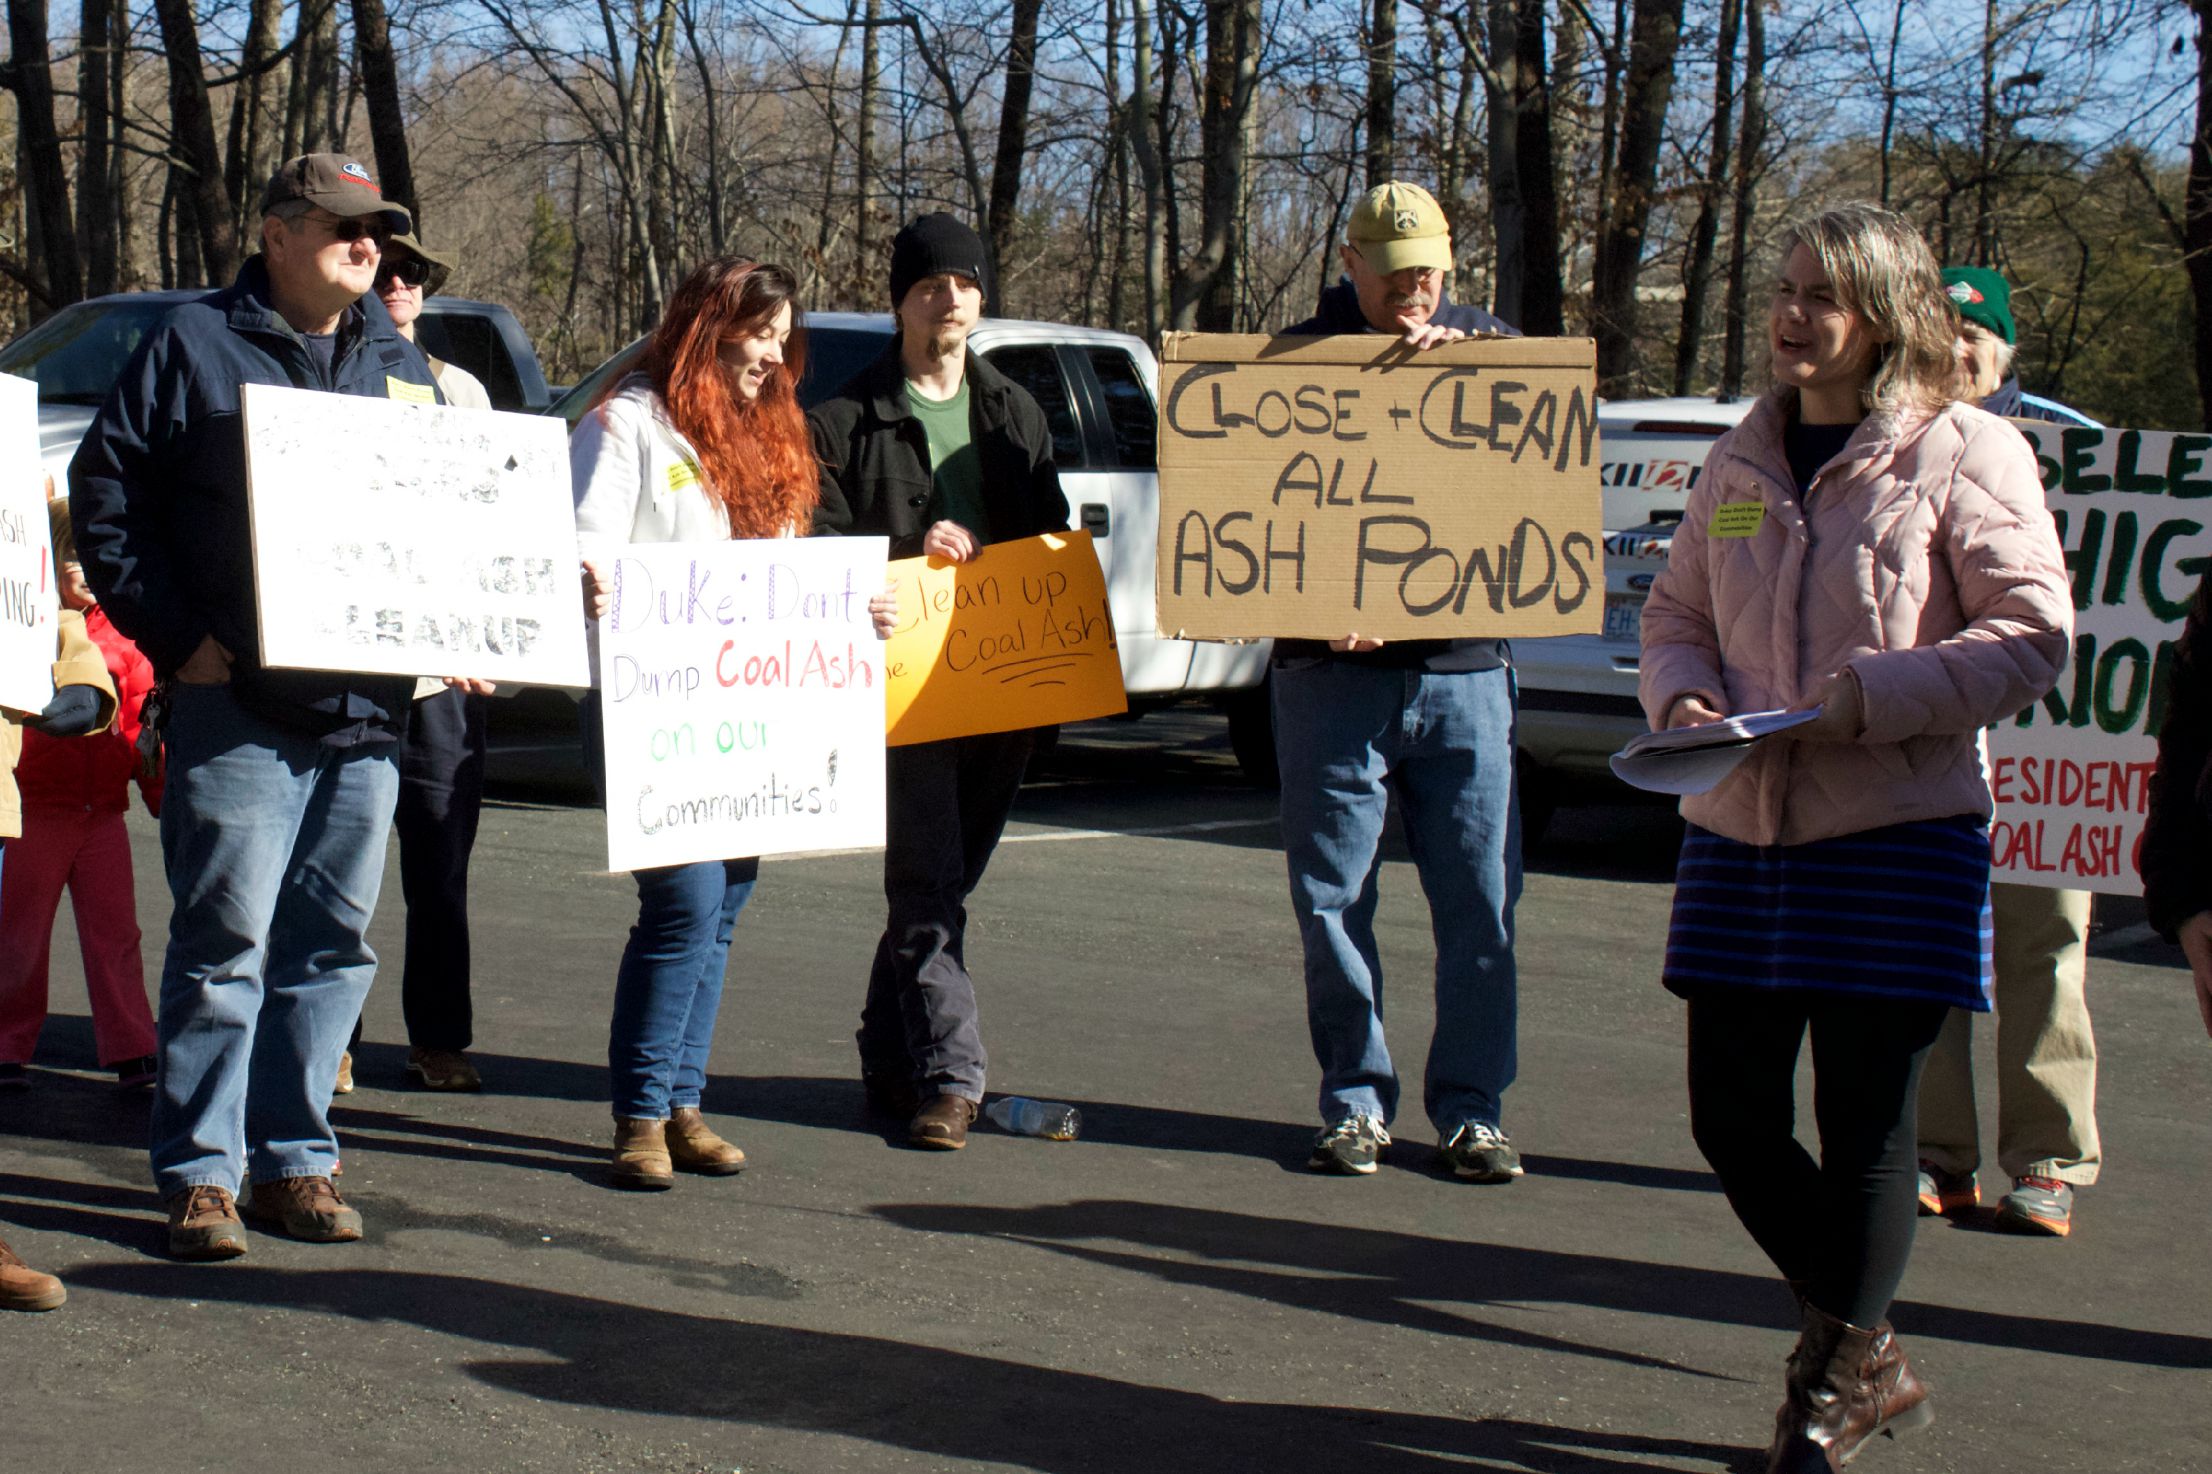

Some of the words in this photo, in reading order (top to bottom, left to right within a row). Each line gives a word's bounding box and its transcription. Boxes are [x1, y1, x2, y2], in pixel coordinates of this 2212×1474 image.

[1166, 362, 1367, 441] CLOSE
[1419, 365, 1598, 472] CLEAN
[1272, 450, 1414, 508] ALL
[1022, 570, 1068, 608] up
[1174, 509, 1305, 597] ASH
[1353, 514, 1594, 617] PONDS
[312, 603, 543, 659] LEANUP
[945, 617, 1027, 673] Coal
[1040, 597, 1117, 650] Ash!
[612, 654, 701, 703] Dump
[715, 638, 791, 688] Coal
[798, 639, 874, 689] Ash
[650, 721, 695, 762] on
[1993, 755, 2158, 815] ESIDENT
[1989, 819, 2056, 873] OAL
[2060, 822, 2123, 877] ASH
